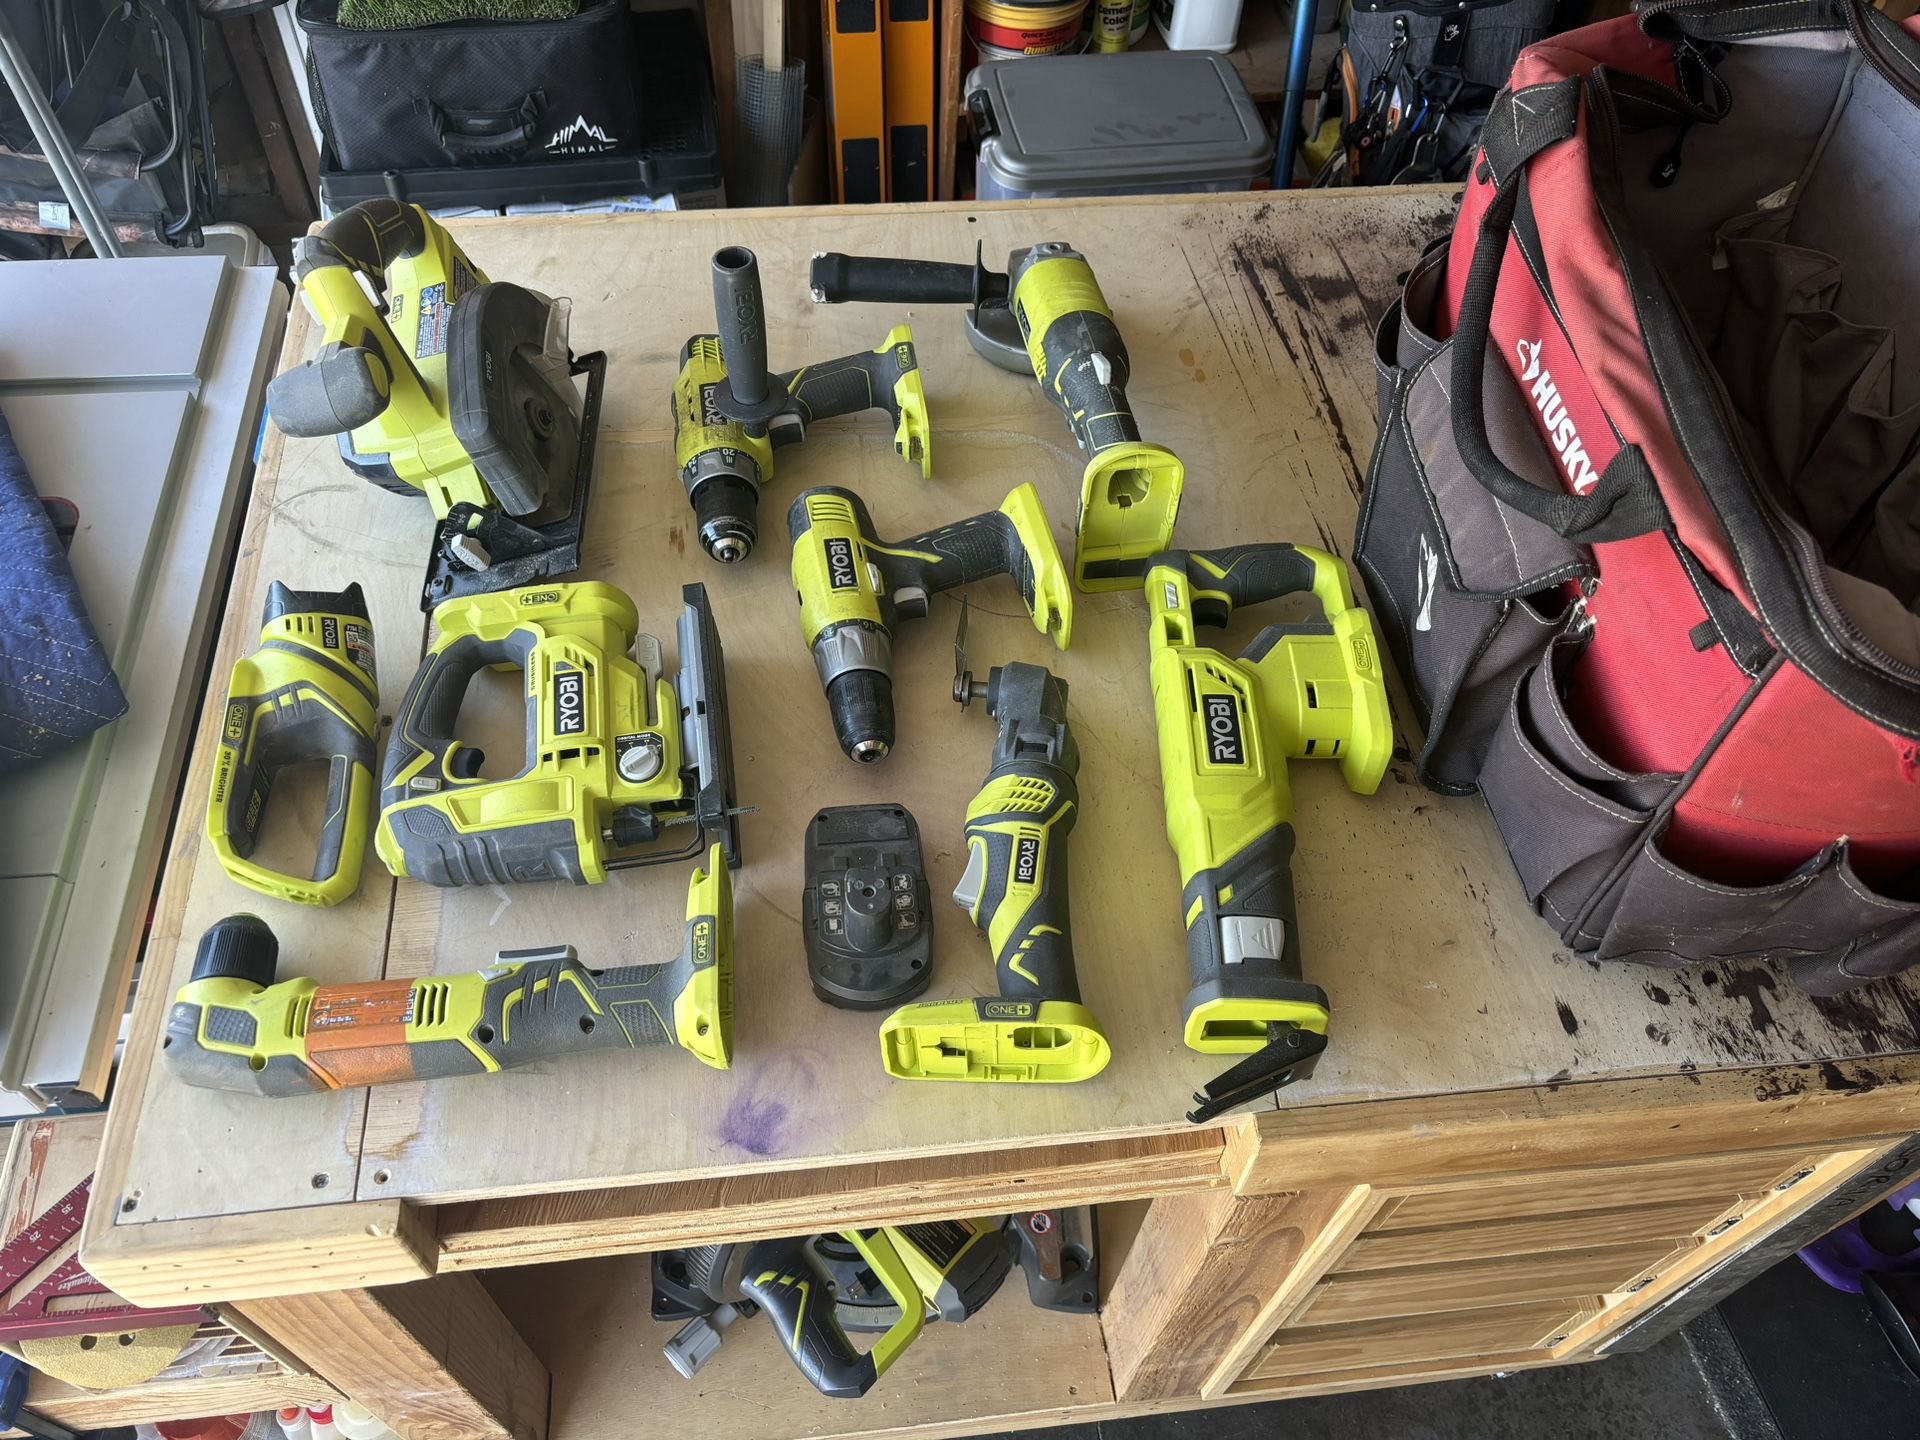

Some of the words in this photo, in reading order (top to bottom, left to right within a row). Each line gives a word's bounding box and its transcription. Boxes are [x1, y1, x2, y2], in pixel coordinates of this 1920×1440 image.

[545, 115, 618, 149] HIMAL
[560, 145, 604, 154] HIMAL
[735, 286, 758, 346] RYOBI
[1530, 369, 1599, 493] HUSKY
[722, 448, 736, 456] 20
[829, 540, 853, 587] RYOBI
[521, 592, 558, 606] ONE+
[323, 619, 337, 648] RYOBI
[560, 675, 580, 732] RYOBI
[228, 706, 244, 737] ONE+
[1207, 698, 1237, 761] RYOBI
[215, 768, 229, 804] BRIGHTER
[1018, 841, 1036, 880] RYOBI
[697, 922, 708, 959] ONE+
[990, 1004, 1030, 1016] ONE+
[61, 1203, 74, 1215] 35
